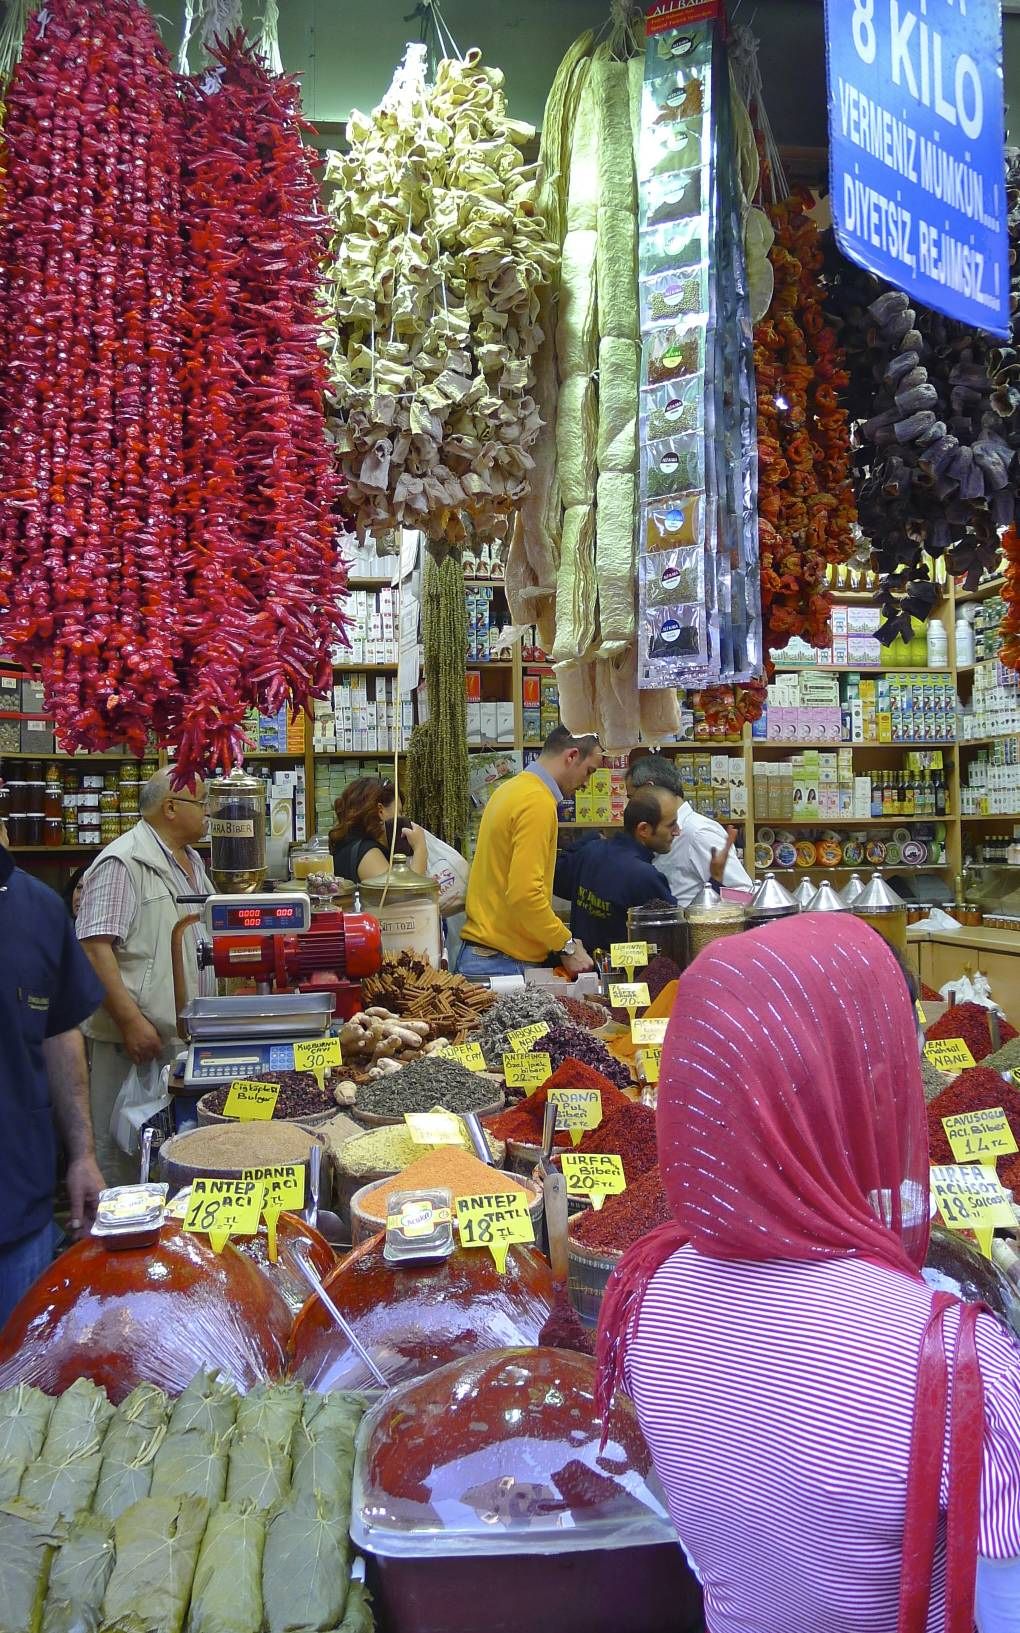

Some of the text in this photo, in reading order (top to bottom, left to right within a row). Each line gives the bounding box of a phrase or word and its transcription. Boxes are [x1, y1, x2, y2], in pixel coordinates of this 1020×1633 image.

[852, 0, 876, 65] 8
[839, 76, 918, 184] VERMENİZ
[646, 1049, 662, 1059] LÜ
[935, 1054, 968, 1067] NANE
[303, 1055, 325, 1069] 30
[551, 1092, 597, 1103] ADANA
[965, 1137, 990, 1155] 14
[566, 1155, 612, 1166] URFA
[244, 1167, 295, 1181] ADANA
[932, 1166, 985, 1183] URFA
[194, 1181, 256, 1196] ANTEP
[272, 1179, 298, 1192] ACI
[222, 1196, 252, 1208] ACI
[457, 1194, 517, 1213] ANTEP
[943, 1197, 971, 1222] 18
[187, 1200, 221, 1230] 18
[463, 1218, 494, 1243] 18
